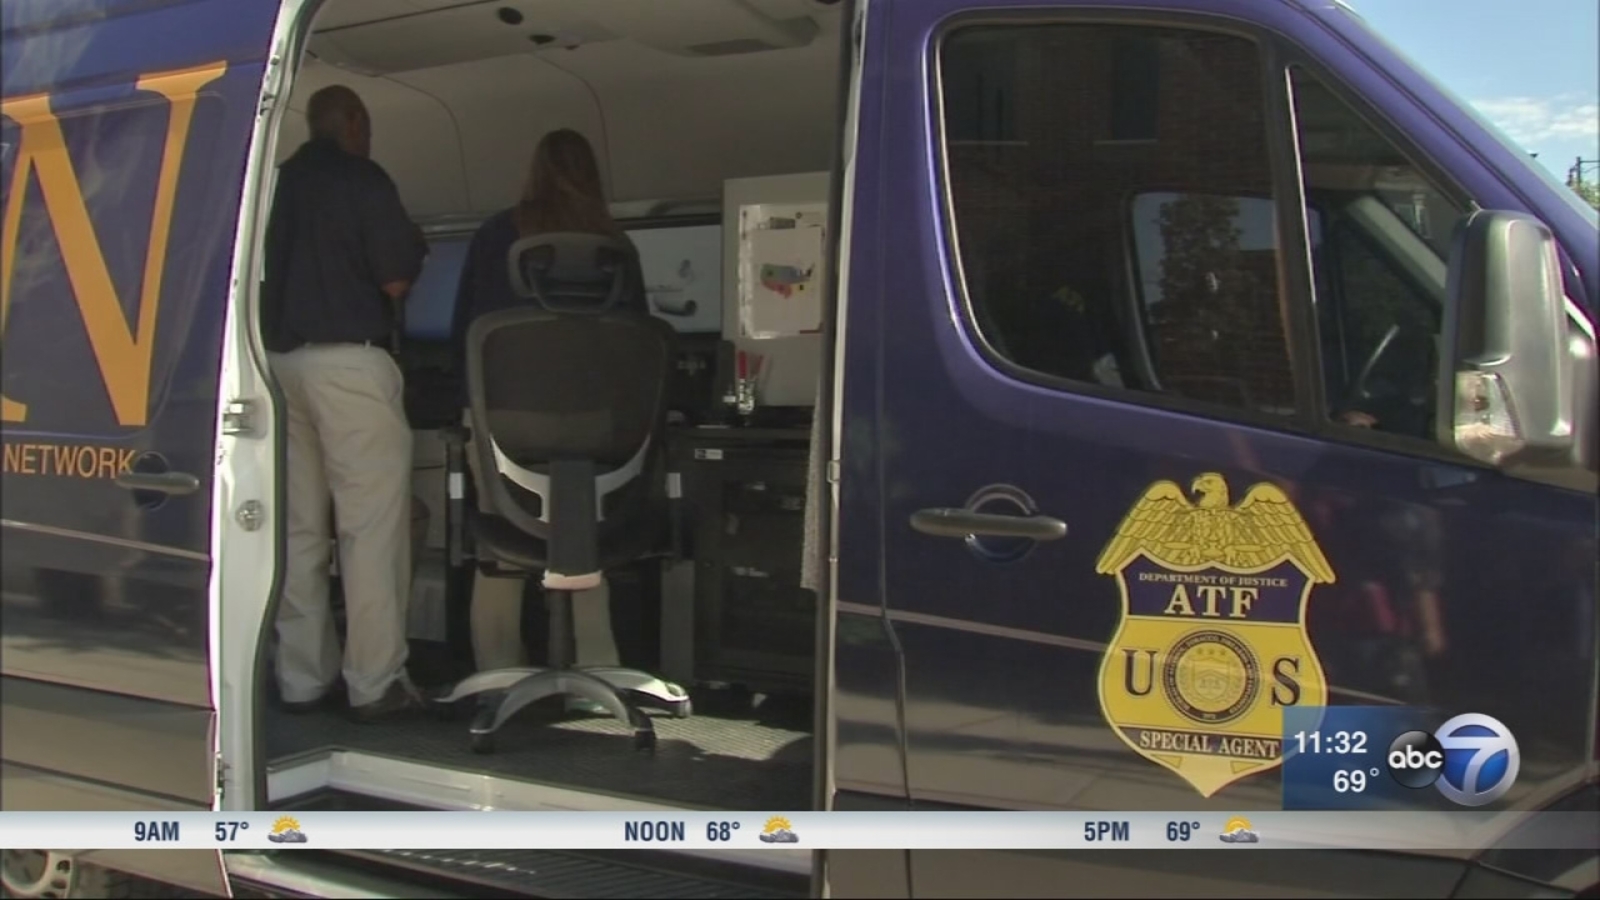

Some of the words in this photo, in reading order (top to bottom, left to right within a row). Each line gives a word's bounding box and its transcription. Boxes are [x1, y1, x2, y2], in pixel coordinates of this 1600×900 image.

[0, 60, 227, 426] N
[3, 443, 136, 479] NETWORK
[1139, 572, 1217, 584] DEPARTMENT
[1219, 575, 1237, 585] OF
[1239, 577, 1288, 587] JUSTICE
[1164, 584, 1259, 618] ATF
[1122, 649, 1158, 695] U
[1271, 657, 1301, 706] S
[1140, 730, 1212, 753] SPECIAL
[1218, 737, 1279, 758] AGENT
